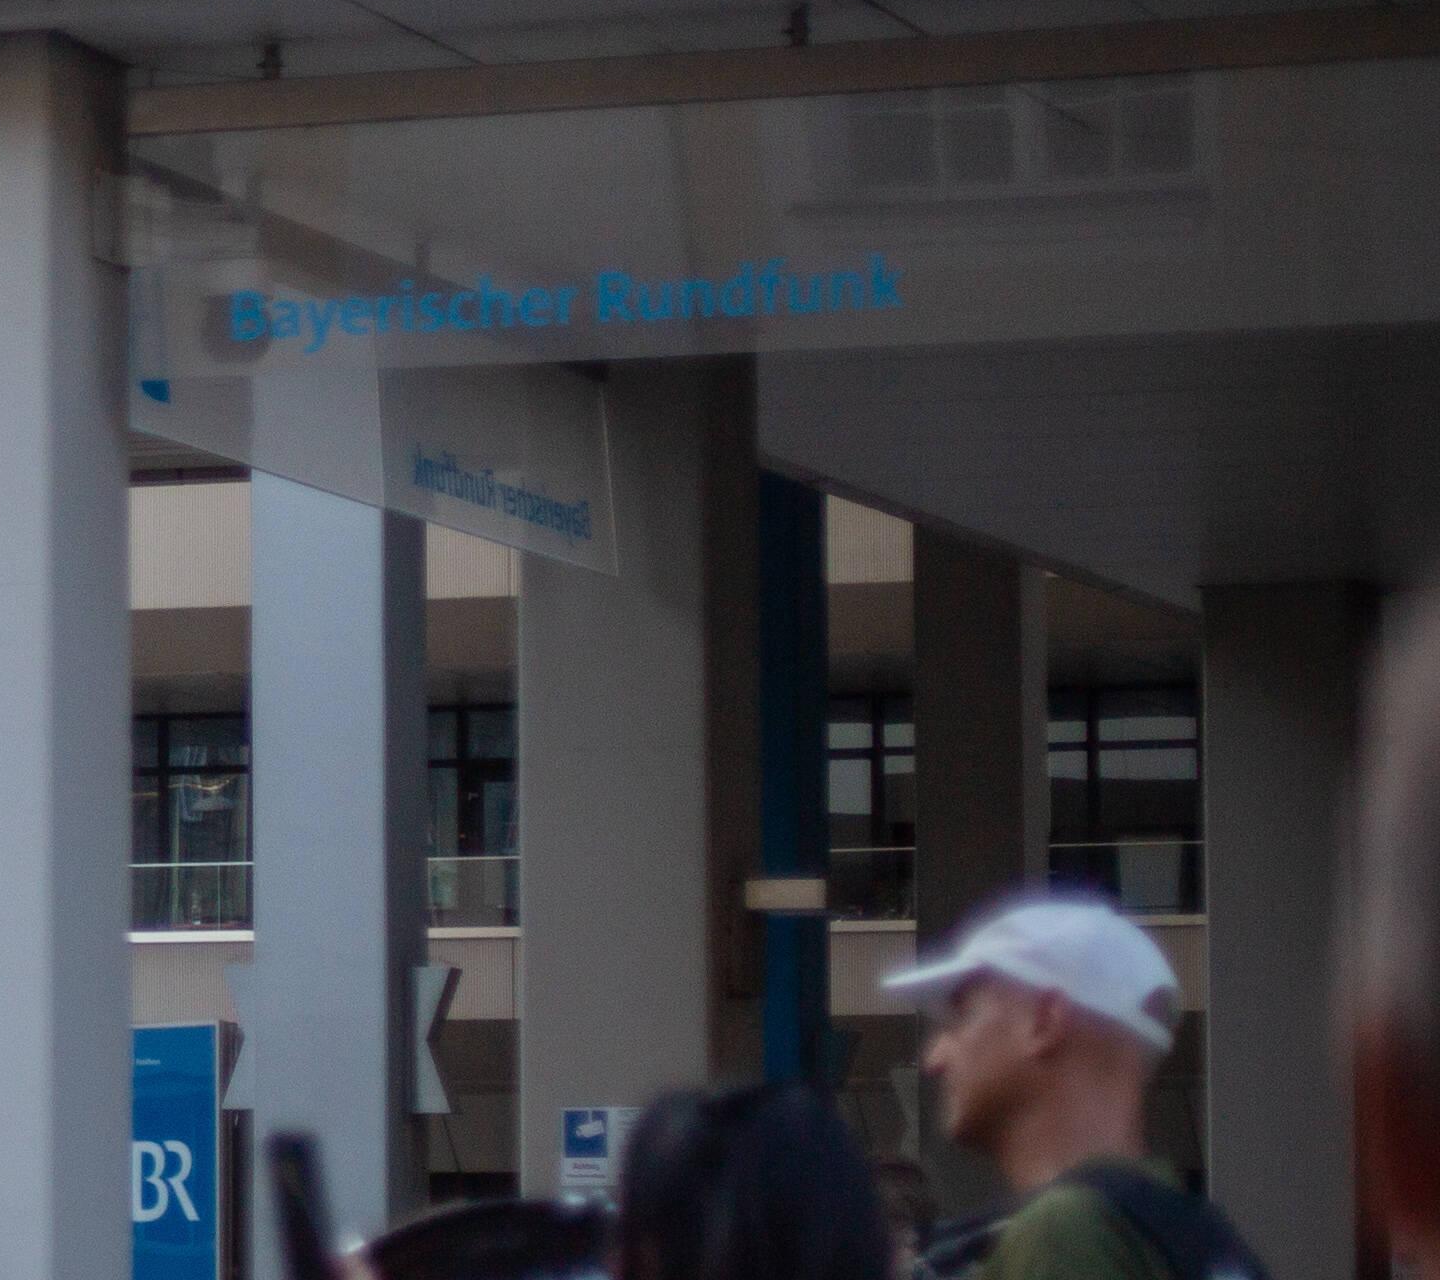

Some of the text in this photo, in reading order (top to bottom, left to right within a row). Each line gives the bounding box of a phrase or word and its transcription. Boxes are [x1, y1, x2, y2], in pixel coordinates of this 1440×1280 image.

[228, 251, 907, 356] Bayerischer Rundfunk
[131, 1139, 201, 1222] BR
